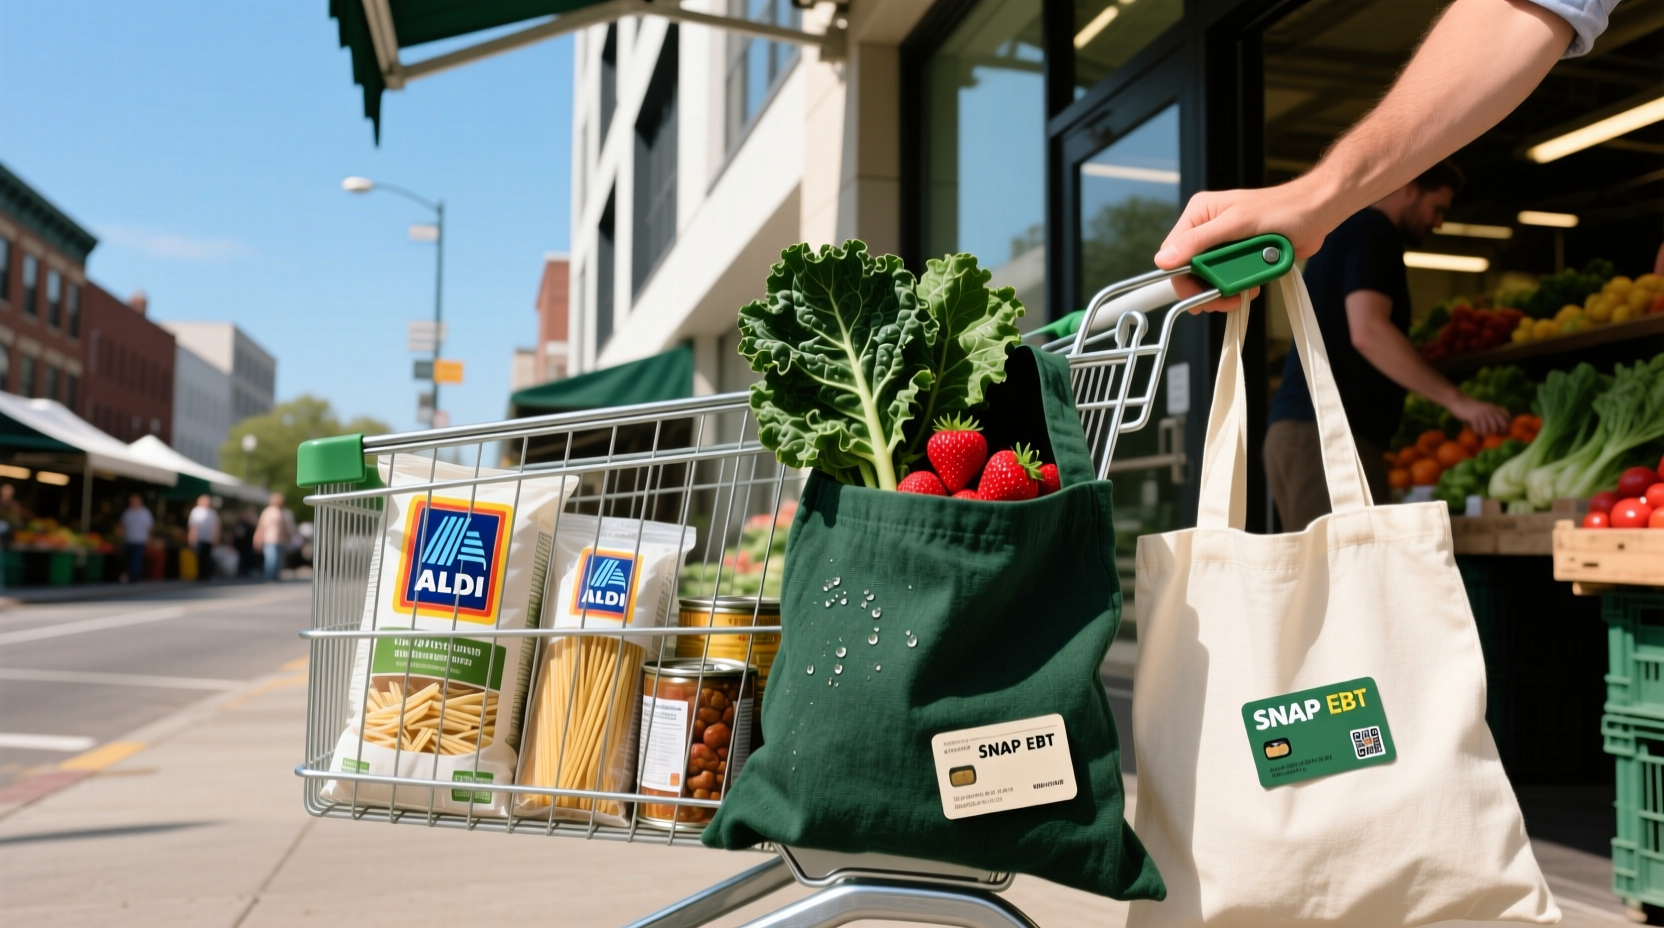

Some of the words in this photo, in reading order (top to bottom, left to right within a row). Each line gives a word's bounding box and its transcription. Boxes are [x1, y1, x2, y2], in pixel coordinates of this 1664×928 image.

[414, 569, 485, 598] ALDI
[581, 588, 626, 607] ALDI
[1253, 698, 1321, 731] SNAP
[1325, 687, 1367, 715] EBT
[978, 739, 1022, 759] SNAP
[1026, 732, 1055, 751] EBT
